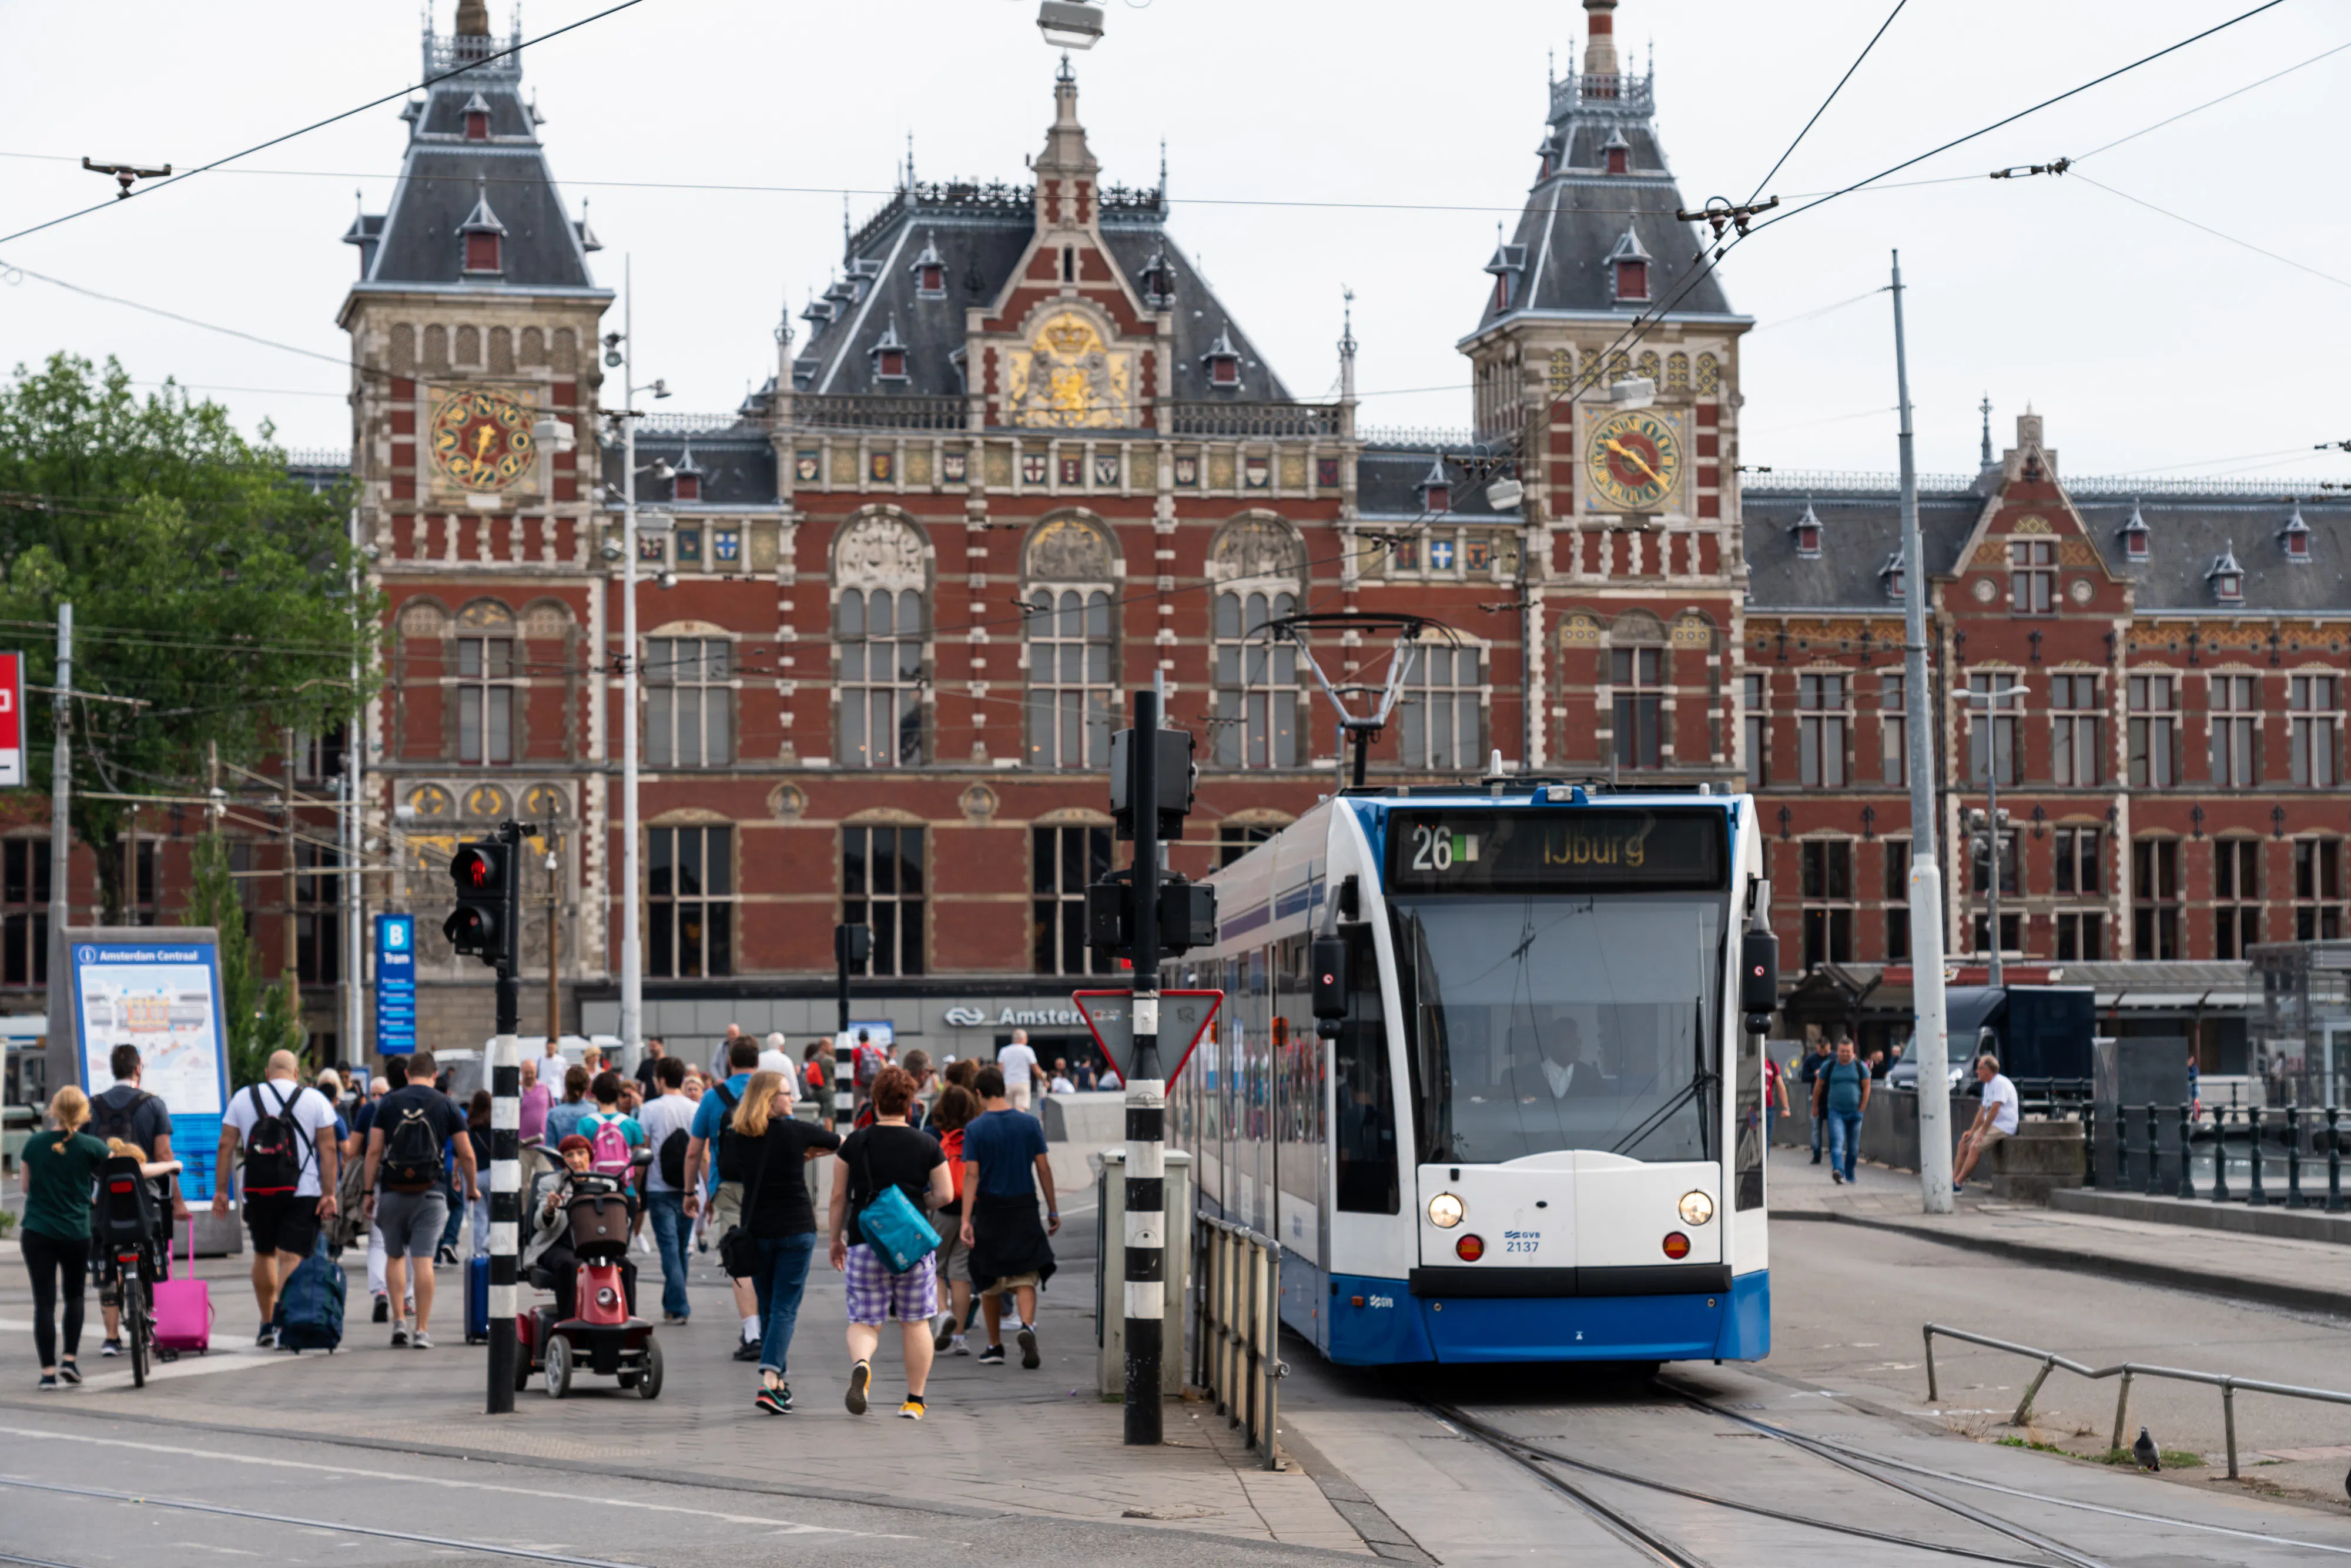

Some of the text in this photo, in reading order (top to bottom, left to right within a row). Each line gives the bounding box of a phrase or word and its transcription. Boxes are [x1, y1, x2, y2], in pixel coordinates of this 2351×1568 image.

[1412, 825, 1645, 871] 26 IJburg
[390, 923, 404, 947] B
[100, 949, 198, 961] Amsterdam Centraal
[384, 951, 410, 964] Tram
[1506, 1241, 1539, 1252] 2137
